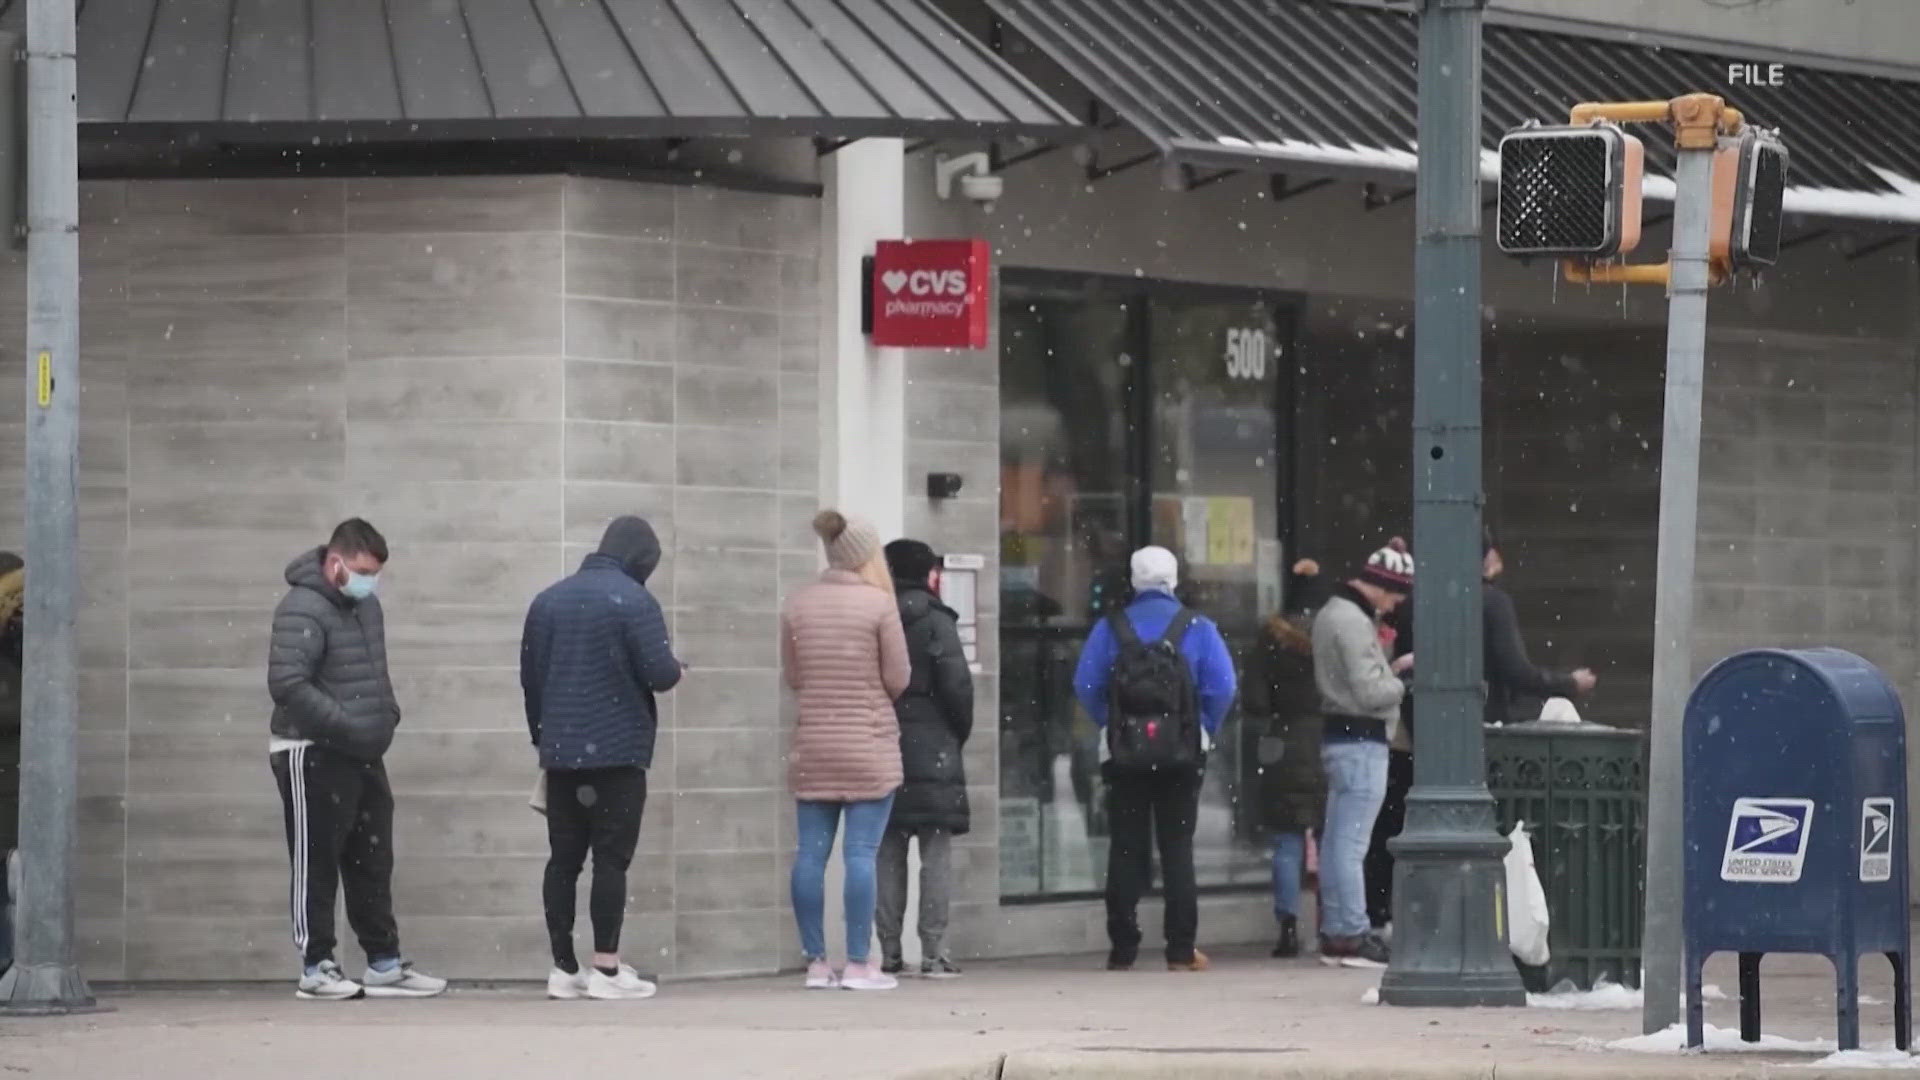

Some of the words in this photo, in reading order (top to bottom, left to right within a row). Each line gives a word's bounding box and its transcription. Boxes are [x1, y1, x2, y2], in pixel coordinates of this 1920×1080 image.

[909, 269, 967, 295] CVS
[885, 300, 964, 318] pharmacy
[1226, 327, 1265, 379] 500
